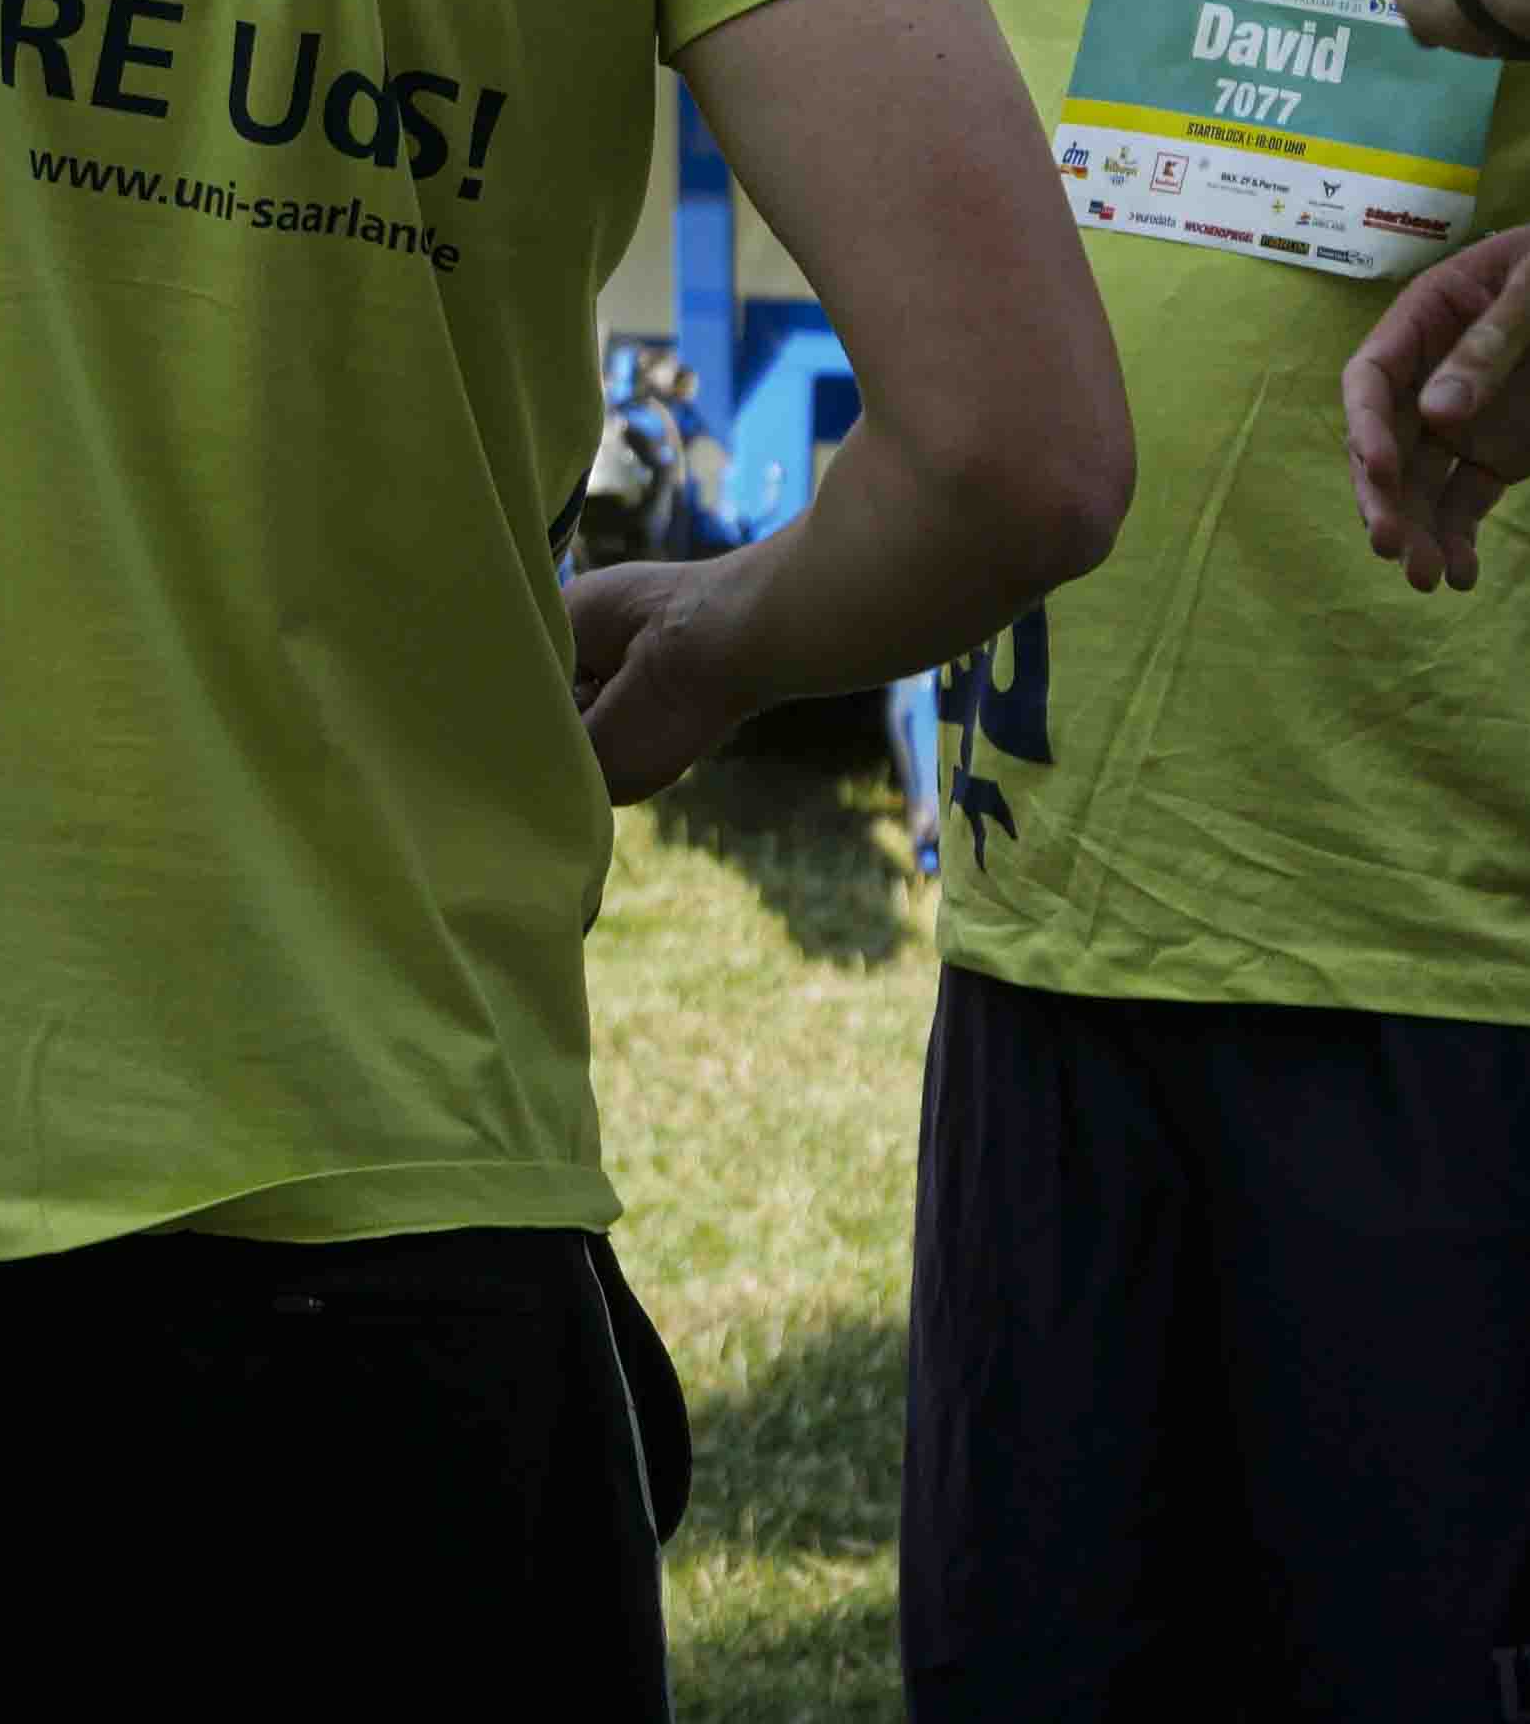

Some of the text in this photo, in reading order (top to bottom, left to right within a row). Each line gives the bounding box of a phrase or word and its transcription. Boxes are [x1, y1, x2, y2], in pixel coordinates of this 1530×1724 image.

[1192, 2, 1351, 85] David
[1214, 78, 1302, 126] 7077
[1062, 140, 1090, 166] dm
[1186, 121, 1244, 146] STARTBLOCK
[1284, 138, 1307, 156] UHR
